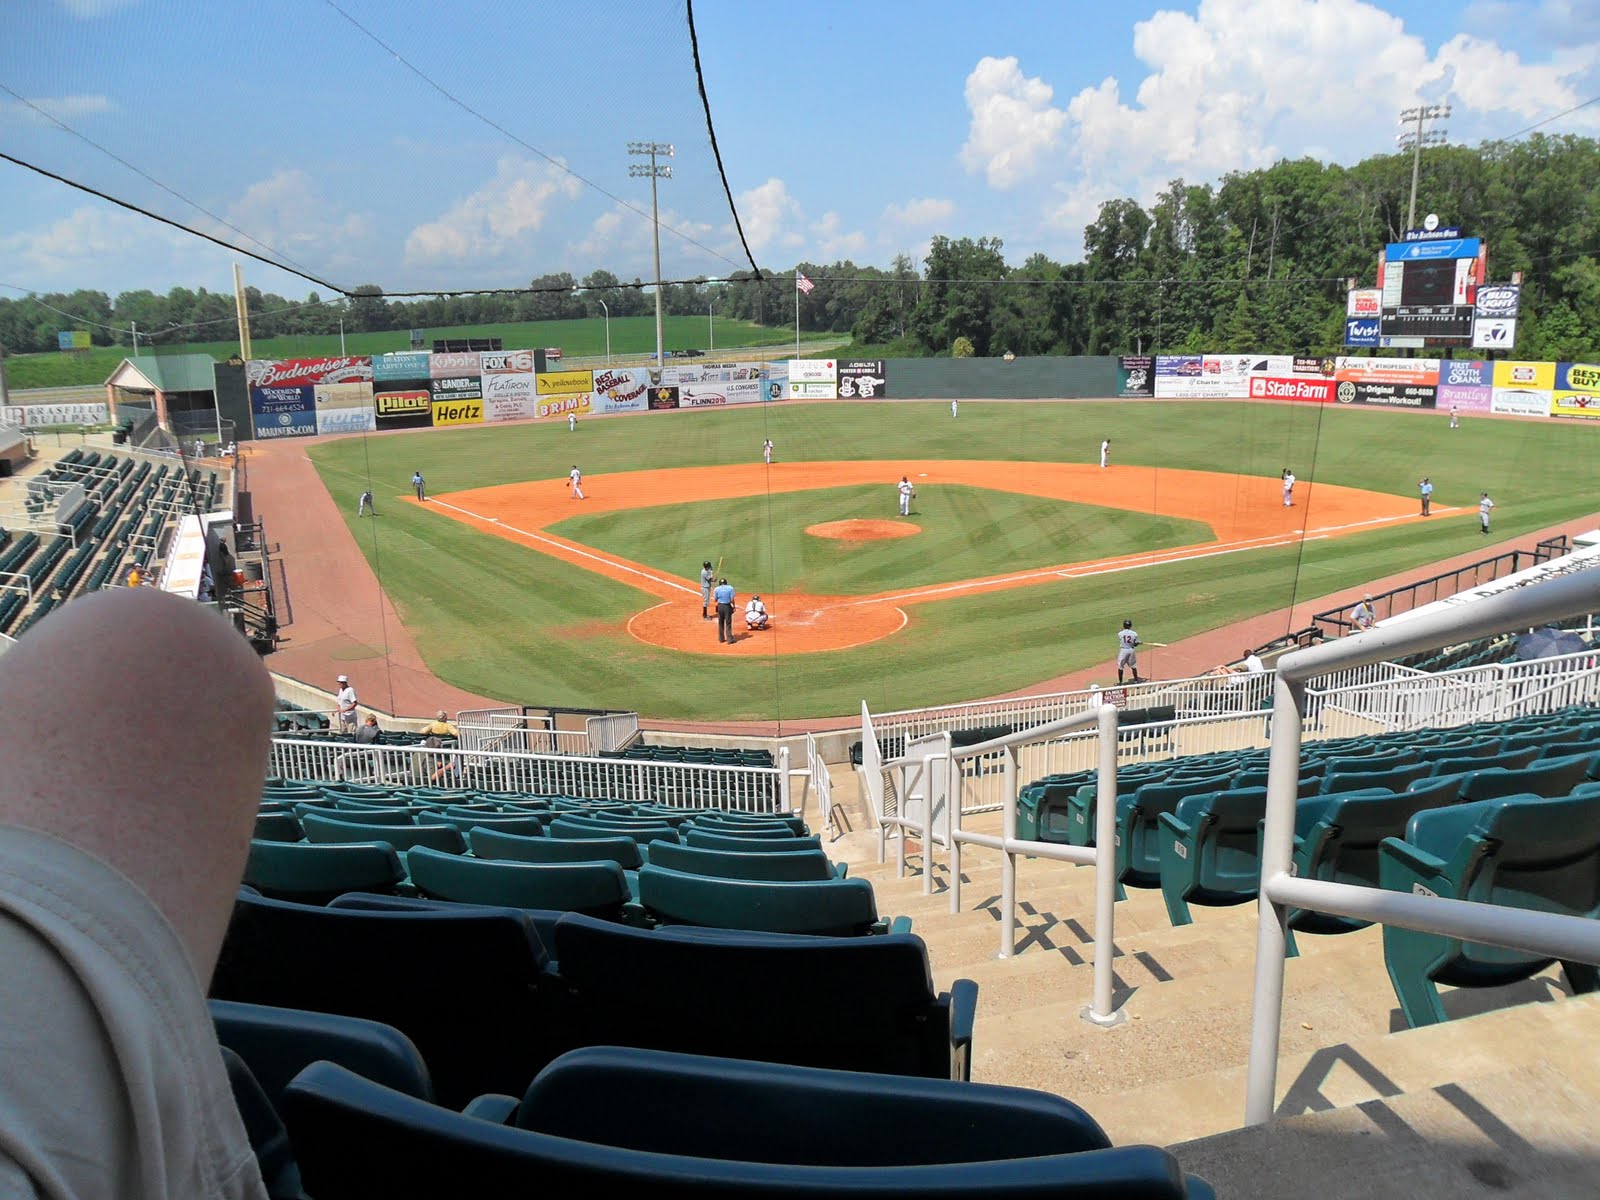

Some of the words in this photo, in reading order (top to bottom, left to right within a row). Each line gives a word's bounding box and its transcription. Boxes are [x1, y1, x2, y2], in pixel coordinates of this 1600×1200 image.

[1486, 291, 1512, 300] BUD
[1356, 303, 1378, 311] GUARD
[430, 355, 478, 368] Kubota
[482, 357, 506, 370] FOX
[509, 354, 532, 370] 16
[252, 358, 350, 387] Budweiser
[552, 378, 588, 388] yellowbook
[595, 371, 612, 386] BEST
[1572, 378, 1598, 387] BUY
[442, 379, 470, 389] GANDER
[596, 375, 630, 395] BASEBALL
[614, 384, 647, 402] COVERAGE
[1366, 386, 1394, 395] Original
[1388, 396, 1422, 405] Workout!
[1442, 389, 1488, 404] Brantley
[540, 393, 590, 416] BRIM'S
[28, 405, 106, 415] BRASFIELD
[437, 405, 480, 420] Hertz
[30, 414, 99, 424] BULLPEN
[258, 426, 314, 437] MARINERS.COM
[1123, 635, 1132, 644] 12
